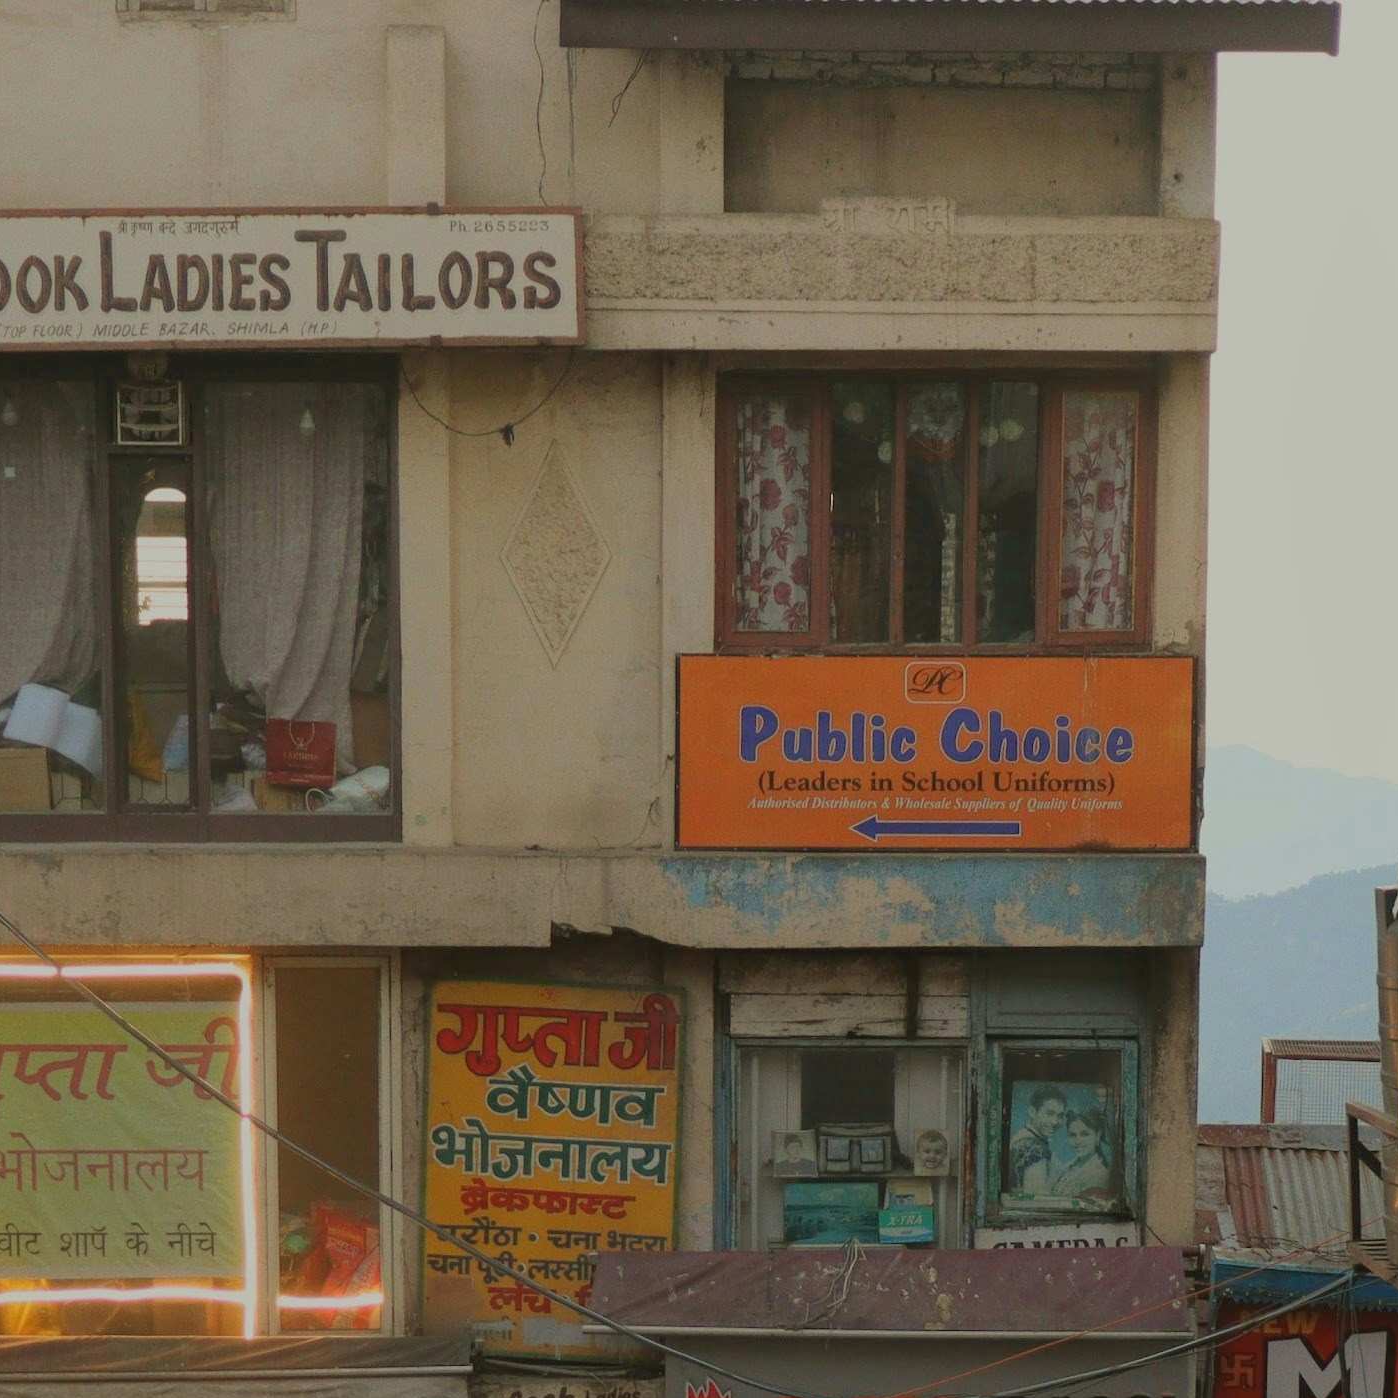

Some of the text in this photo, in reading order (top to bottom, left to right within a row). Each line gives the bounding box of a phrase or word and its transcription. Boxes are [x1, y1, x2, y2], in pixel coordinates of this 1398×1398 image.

[450, 219, 549, 234] Ph. 2655223
[99, 229, 292, 314] LADIES
[294, 228, 563, 312] TAILORS
[93, 323, 149, 338] MIDDLE
[227, 322, 290, 337] SHIMLA
[738, 704, 1136, 765] Public Choice
[747, 796, 1124, 812] Authorised Distributors & Wholesale Suppliers of Quality Uniforms
[757, 770, 1117, 795] (Leaders in School Uniforms)
[146, 1016, 243, 1101] जी
[436, 993, 681, 1077] गुप्ता जी
[485, 1062, 666, 1129] वैष्णव
[430, 1117, 674, 1186] भोजनालय
[460, 1178, 636, 1220] ब्रेकफास्ट
[124, 1222, 149, 1258] के
[167, 1221, 218, 1258] नीचे
